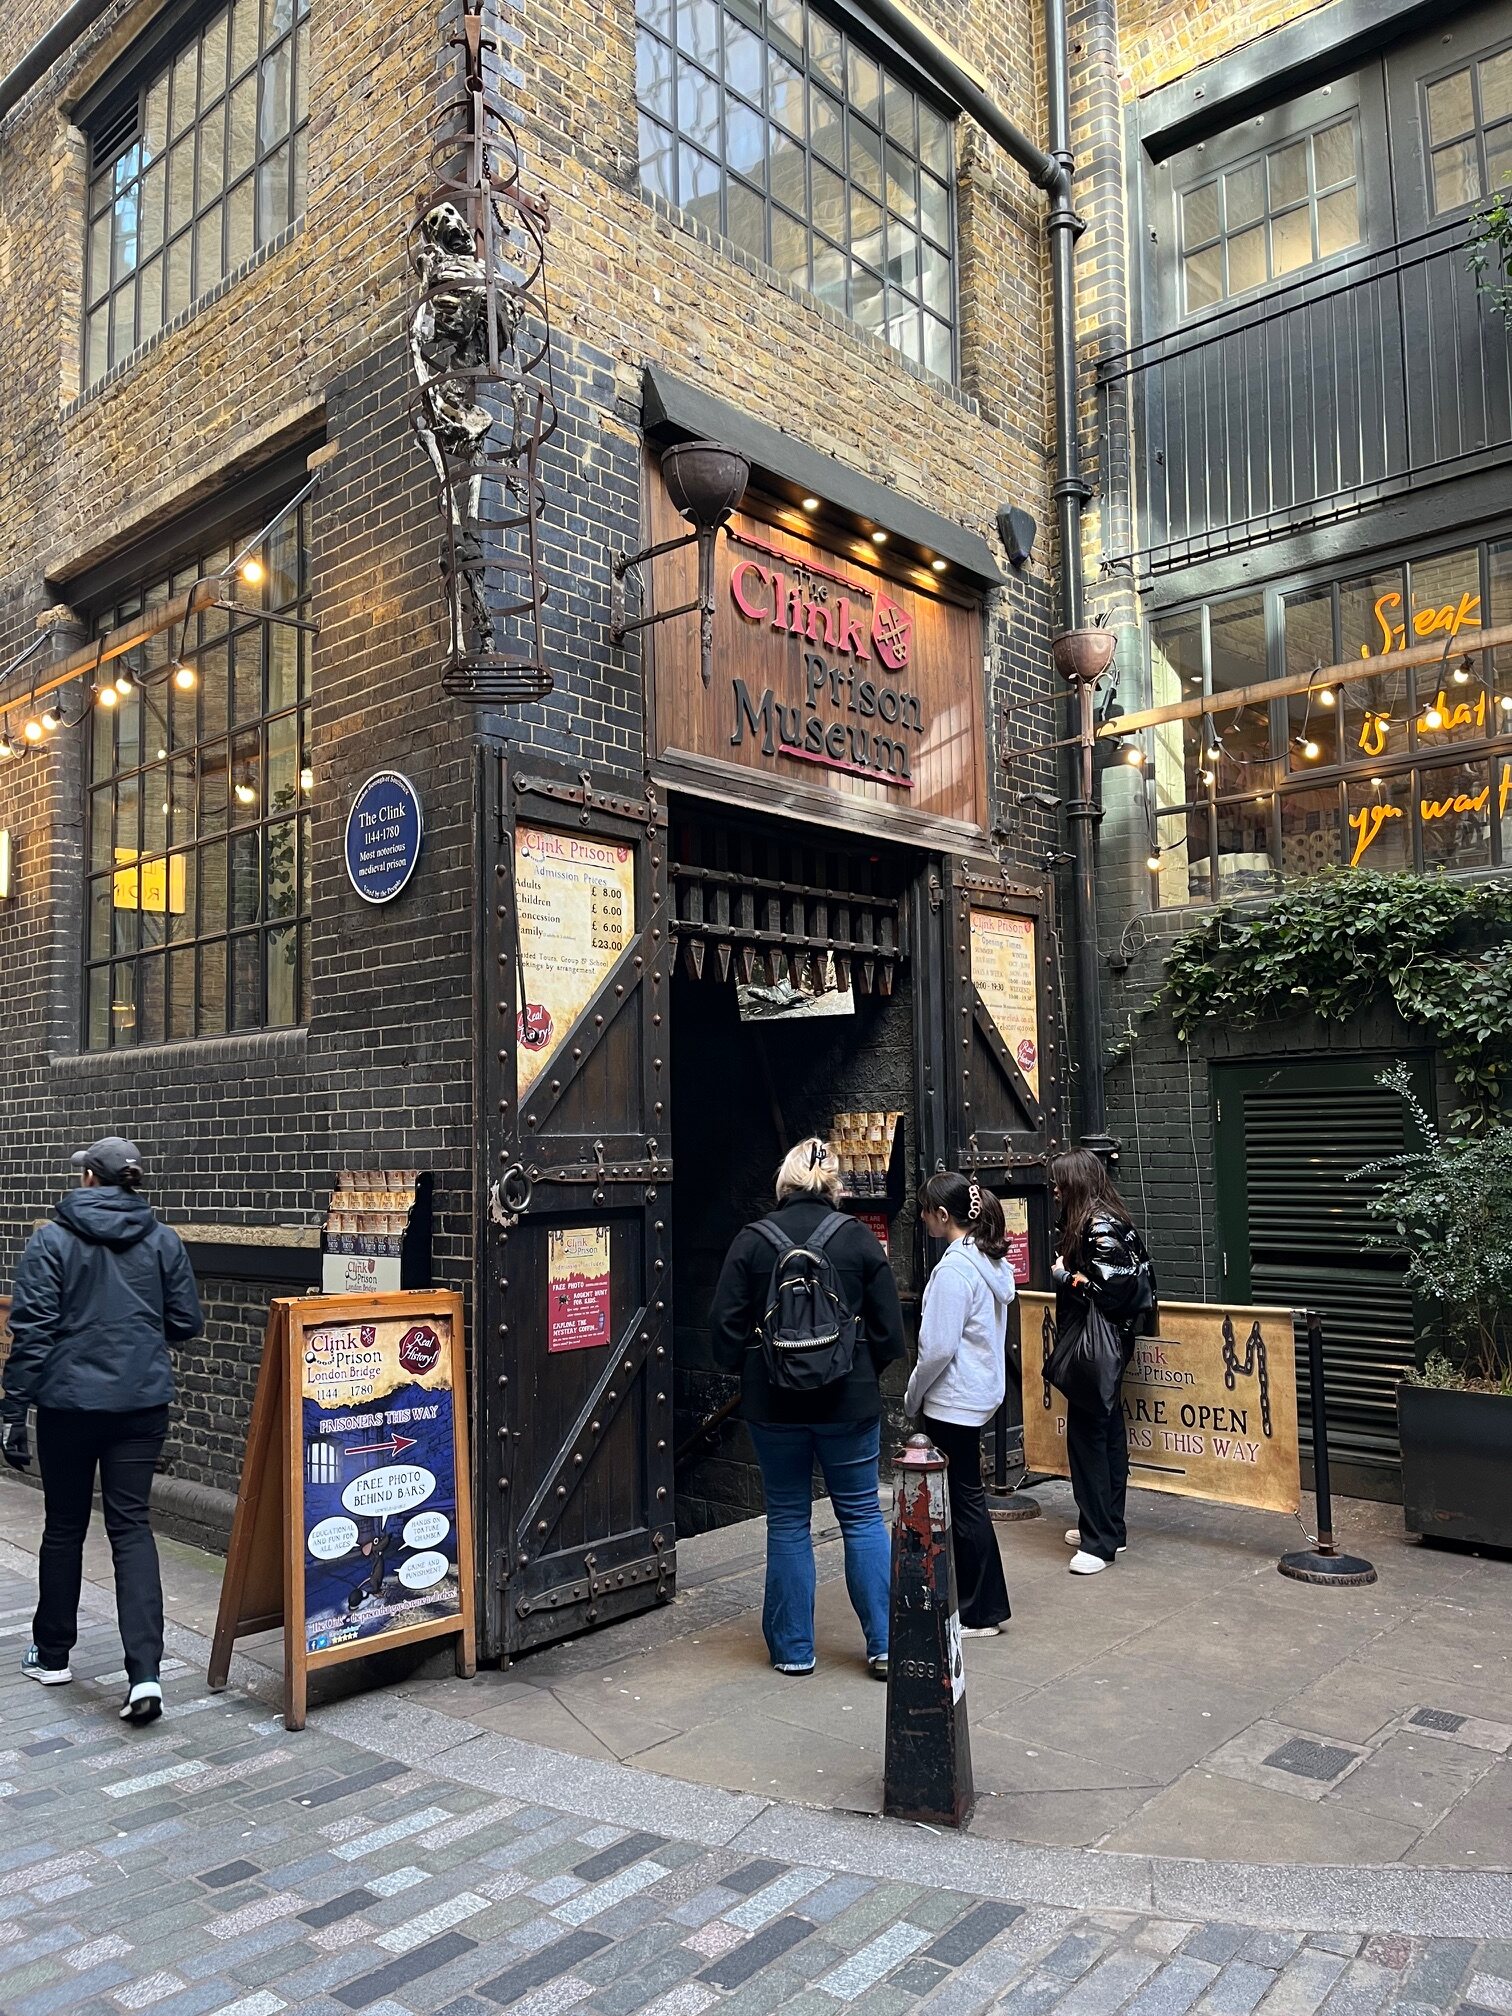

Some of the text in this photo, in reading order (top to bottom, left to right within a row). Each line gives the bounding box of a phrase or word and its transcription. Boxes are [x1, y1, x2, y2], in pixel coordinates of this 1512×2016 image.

[793, 568, 828, 602] The
[730, 560, 872, 661] Clink
[804, 652, 925, 733] Prison
[730, 678, 912, 779] Museum
[1358, 711, 1391, 756] is
[358, 801, 406, 828] The Clink
[365, 825, 400, 845] 1144-1780
[359, 843, 406, 862] Most notorious
[526, 833, 564, 855] Clink
[570, 841, 615, 863] Prison
[358, 858, 407, 877] medieval prison
[534, 865, 607, 886] Admission Prices
[515, 878, 622, 899] Adults £ 8.00
[516, 892, 622, 916] Children £ 6.00
[591, 920, 597, 931] £
[602, 923, 622, 933] 6.00
[972, 917, 1024, 934] Clink Prison
[518, 925, 543, 940] amily
[591, 937, 622, 951] £23.00
[981, 936, 1022, 950] Opening Times
[546, 963, 554, 972] by
[991, 982, 1004, 991] 19:30
[566, 1237, 588, 1248] Clink
[577, 1247, 598, 1256] Prison
[347, 1261, 368, 1273] Clink
[357, 1273, 378, 1284] Prison
[552, 1283, 566, 1291] FREE
[567, 1281, 585, 1290] PHOTO
[552, 1320, 576, 1330] EXPLORE
[552, 1327, 577, 1337] MYSTERY
[311, 1333, 359, 1352] Clink
[410, 1331, 435, 1348] Real
[336, 1351, 382, 1368] Prison
[400, 1343, 438, 1368] History!
[1131, 1346, 1169, 1366] ink
[307, 1365, 381, 1383] London Bridge
[1144, 1365, 1196, 1385] Prison
[317, 1388, 338, 1400] 1144
[350, 1384, 374, 1397] 1780
[319, 1405, 439, 1433] PRISONERS THIS WAY
[1122, 1397, 1168, 1425] ARE
[1180, 1403, 1248, 1435] OPEN
[1160, 1431, 1204, 1455] THIS
[1212, 1438, 1260, 1462] WAY
[356, 1471, 421, 1491] FREE PHOTO
[354, 1484, 426, 1507] BEHIND BARS
[311, 1524, 355, 1539] EDUCATIONAL
[411, 1518, 431, 1528] HANDS
[413, 1524, 440, 1535] TORTURE
[312, 1537, 327, 1546] AND
[342, 1532, 354, 1540] FOR
[414, 1531, 442, 1542] CHAMBER
[320, 1541, 351, 1553] ALL AGES
[405, 1565, 442, 1580] PUNISHMENT
[407, 1561, 425, 1571] CRIME
[350, 1612, 362, 1623] the
[361, 1609, 380, 1623] prison
